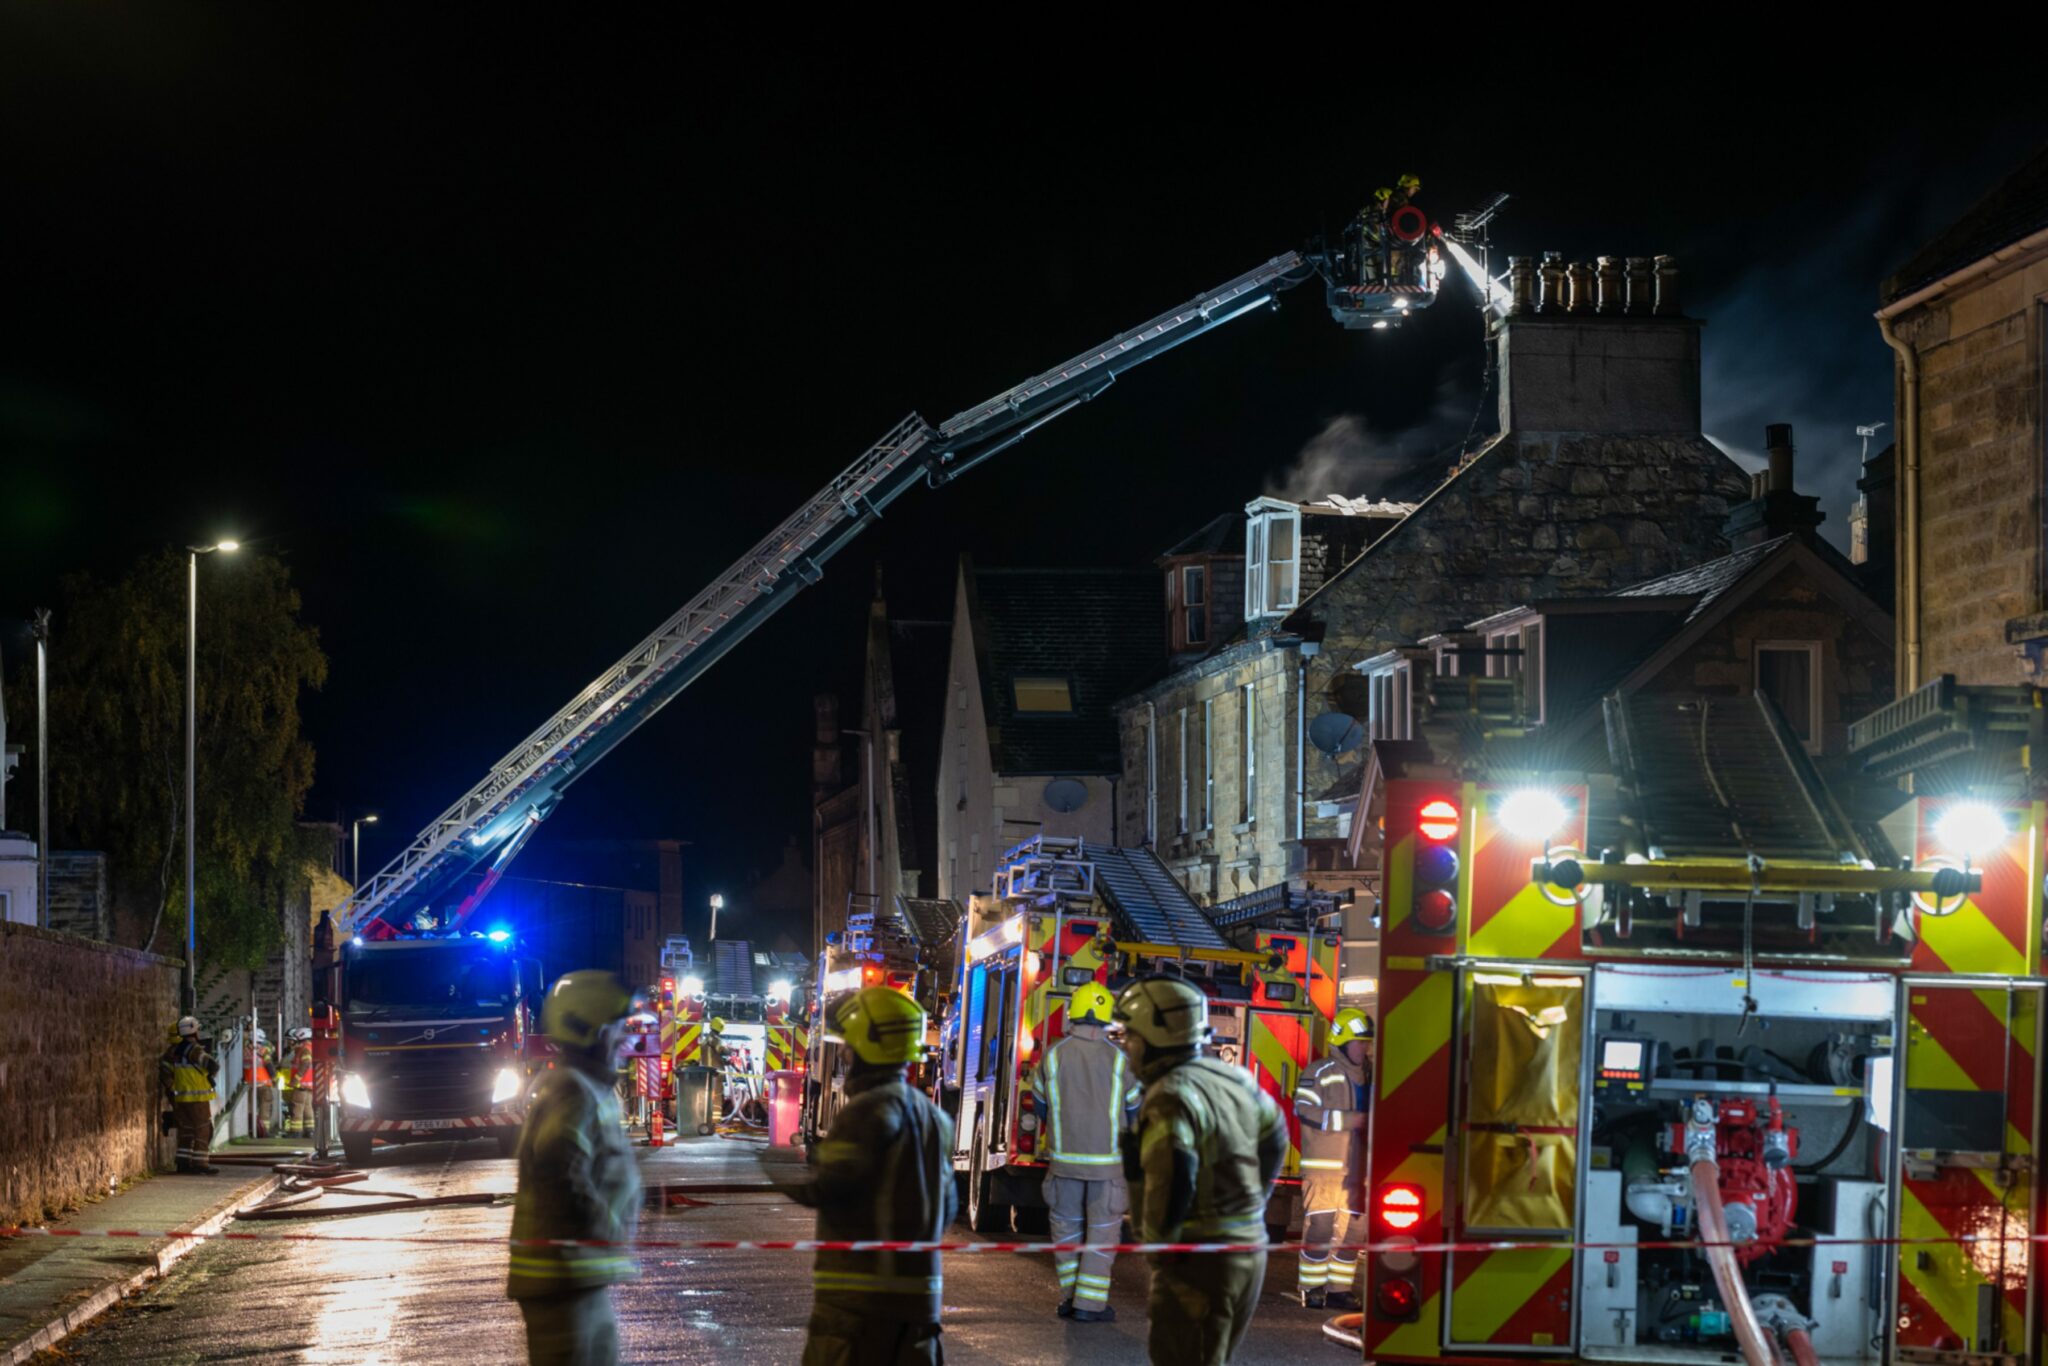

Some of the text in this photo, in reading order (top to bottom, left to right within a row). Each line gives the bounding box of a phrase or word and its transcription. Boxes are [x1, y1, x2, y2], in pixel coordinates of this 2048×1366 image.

[477, 674, 632, 805] SCOTTISH FIRE AND RESCUE SERVICE
